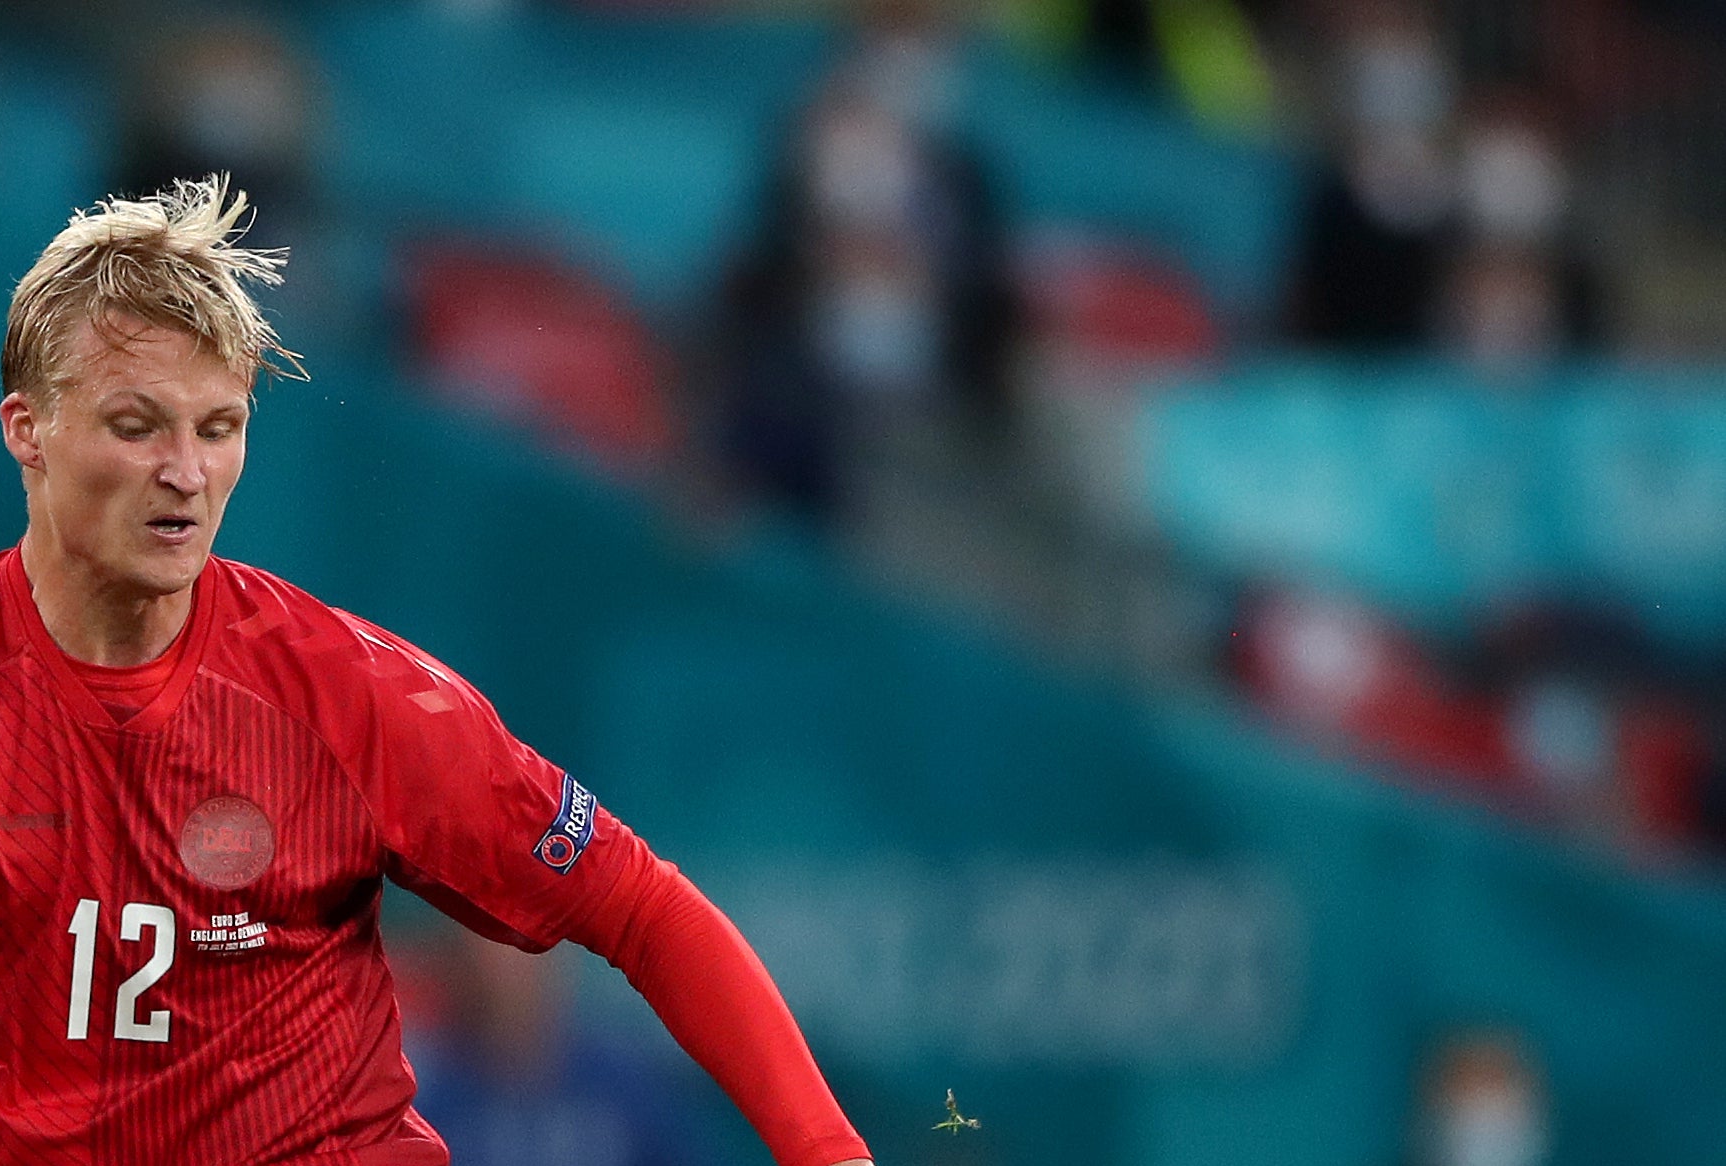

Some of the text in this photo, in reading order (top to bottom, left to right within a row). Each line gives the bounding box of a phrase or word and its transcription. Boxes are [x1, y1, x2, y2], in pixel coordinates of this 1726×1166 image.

[564, 779, 589, 838] RESPECT
[190, 930, 228, 942] ENGLAND
[237, 922, 268, 940] DENMARK
[211, 915, 233, 927] EURO
[67, 898, 175, 1042] 12
